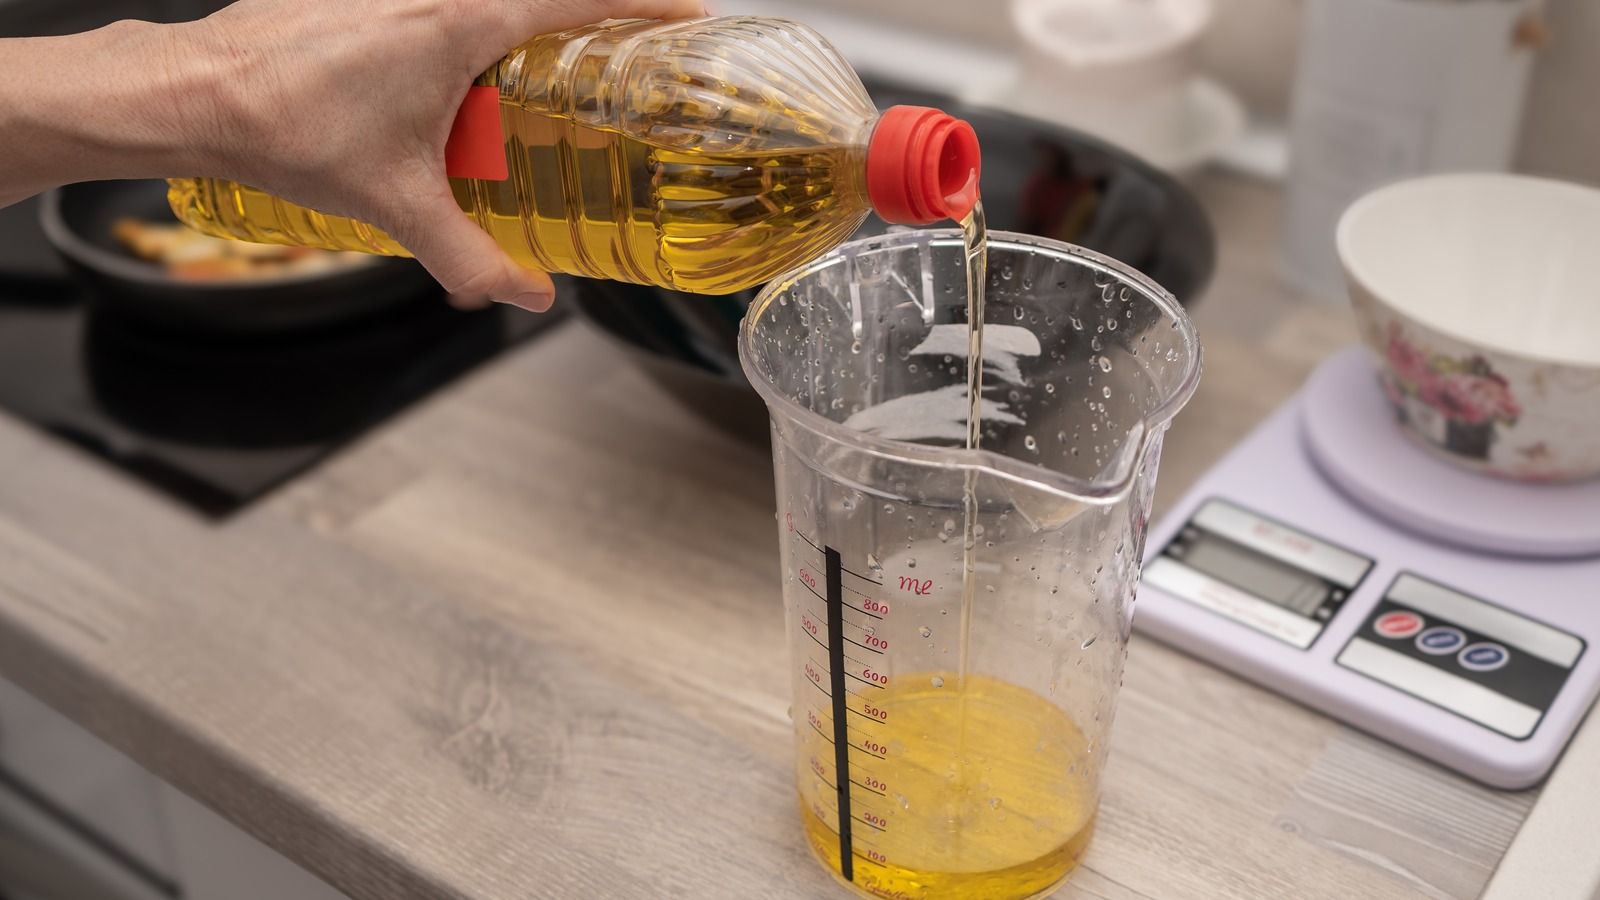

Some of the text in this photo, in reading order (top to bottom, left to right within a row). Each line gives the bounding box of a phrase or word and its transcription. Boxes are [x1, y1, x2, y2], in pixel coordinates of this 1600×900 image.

[799, 568, 816, 588] 600
[863, 598, 889, 615] 800
[864, 634, 888, 650] 700
[862, 669, 888, 685] 600
[864, 704, 887, 720] 500
[864, 740, 887, 755] 400
[864, 776, 887, 791] 300
[864, 812, 887, 827] 200
[867, 850, 887, 863] 100
